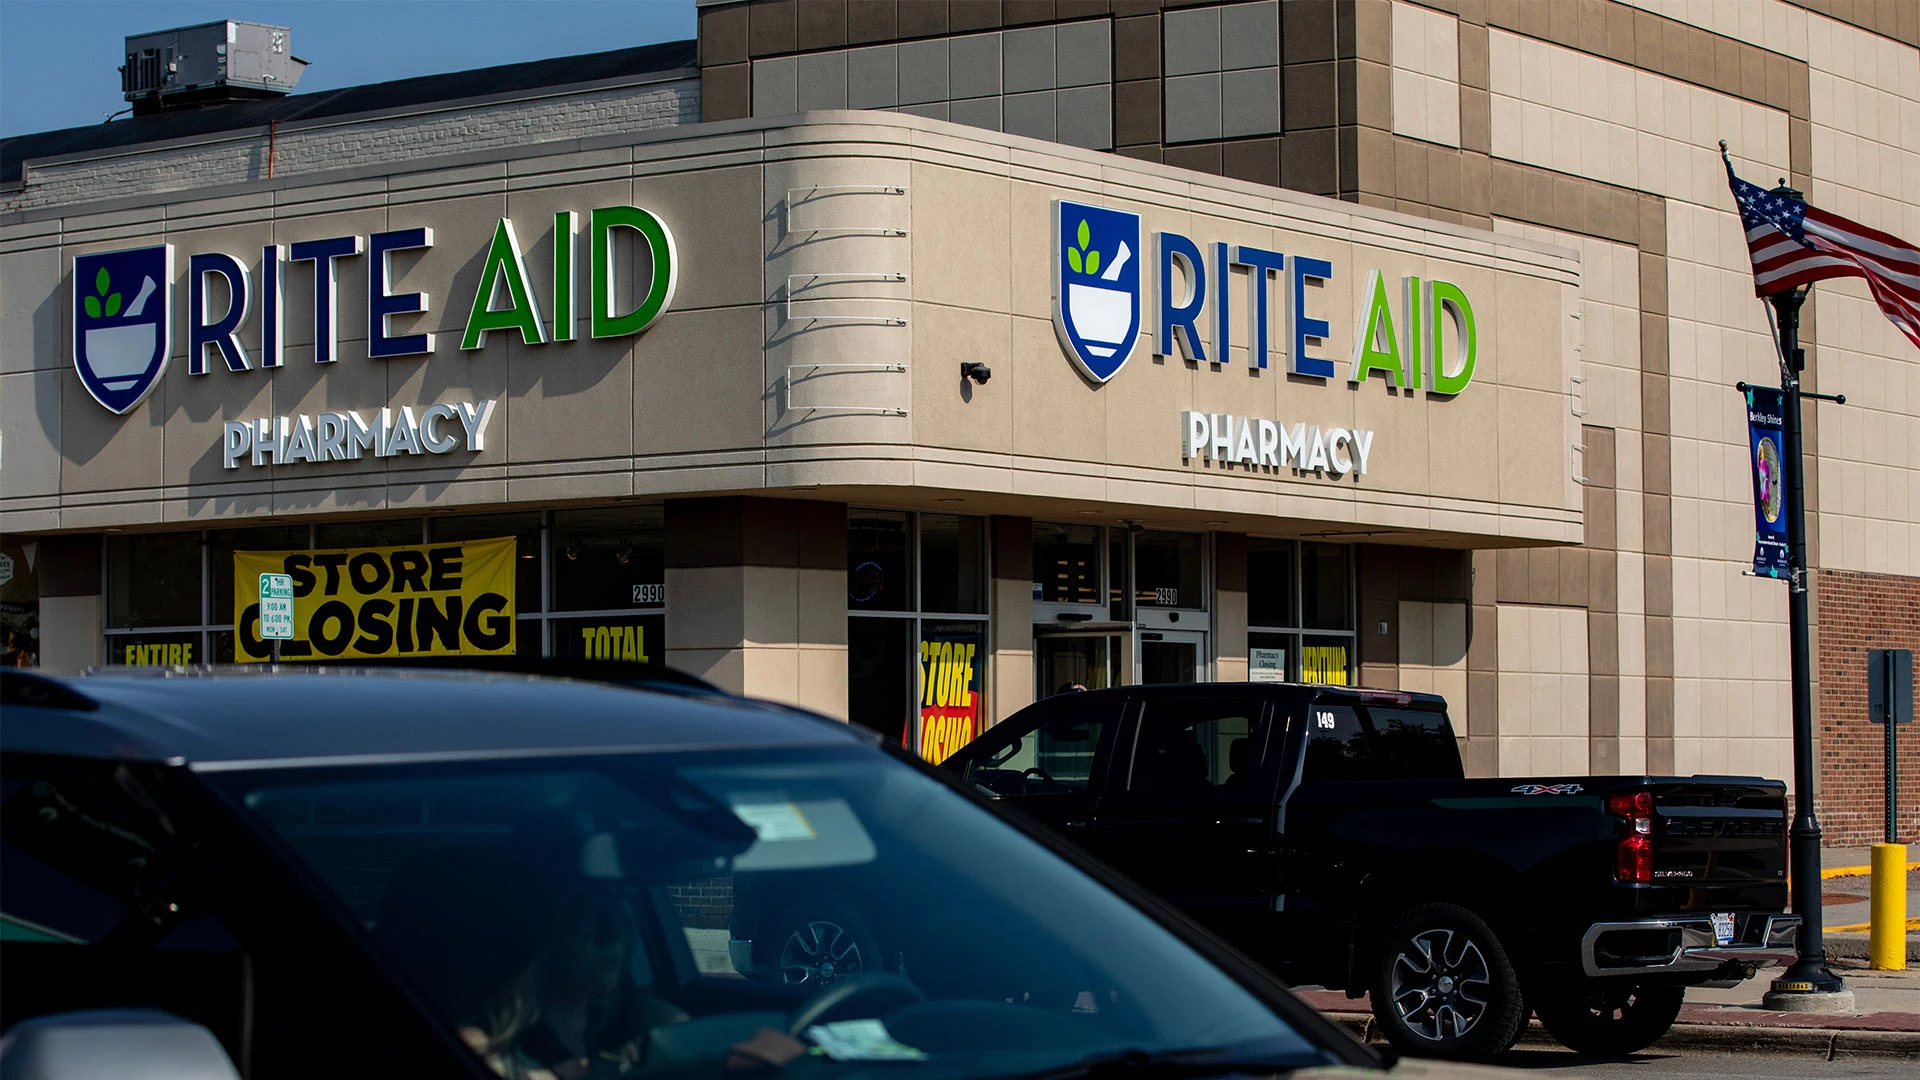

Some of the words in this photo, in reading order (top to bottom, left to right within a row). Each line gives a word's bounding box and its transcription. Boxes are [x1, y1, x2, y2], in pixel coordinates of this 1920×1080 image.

[188, 227, 436, 375] RITE
[460, 204, 679, 350] AID
[1151, 231, 1335, 380] RITE
[1348, 268, 1478, 396] AID
[1750, 411, 1767, 425] Berkley
[1767, 413, 1782, 426] Shines
[224, 400, 497, 469] PHARMACY
[1182, 410, 1374, 476] PHARMACY
[283, 546, 464, 598] STORE
[262, 578, 269, 595] 2
[271, 587, 291, 597] PARKING
[633, 584, 665, 603] 2990
[1156, 588, 1177, 604] 2990
[279, 603, 287, 611] AM
[264, 613, 269, 622] TO
[582, 626, 649, 664] TOTAL
[125, 643, 192, 667] ENTIRE
[1256, 650, 1279, 661] Pharmacy
[920, 641, 976, 708] STORE
[1259, 660, 1276, 670] Closing
[1302, 646, 1347, 686] VERYTHING
[1316, 711, 1335, 729] 149
